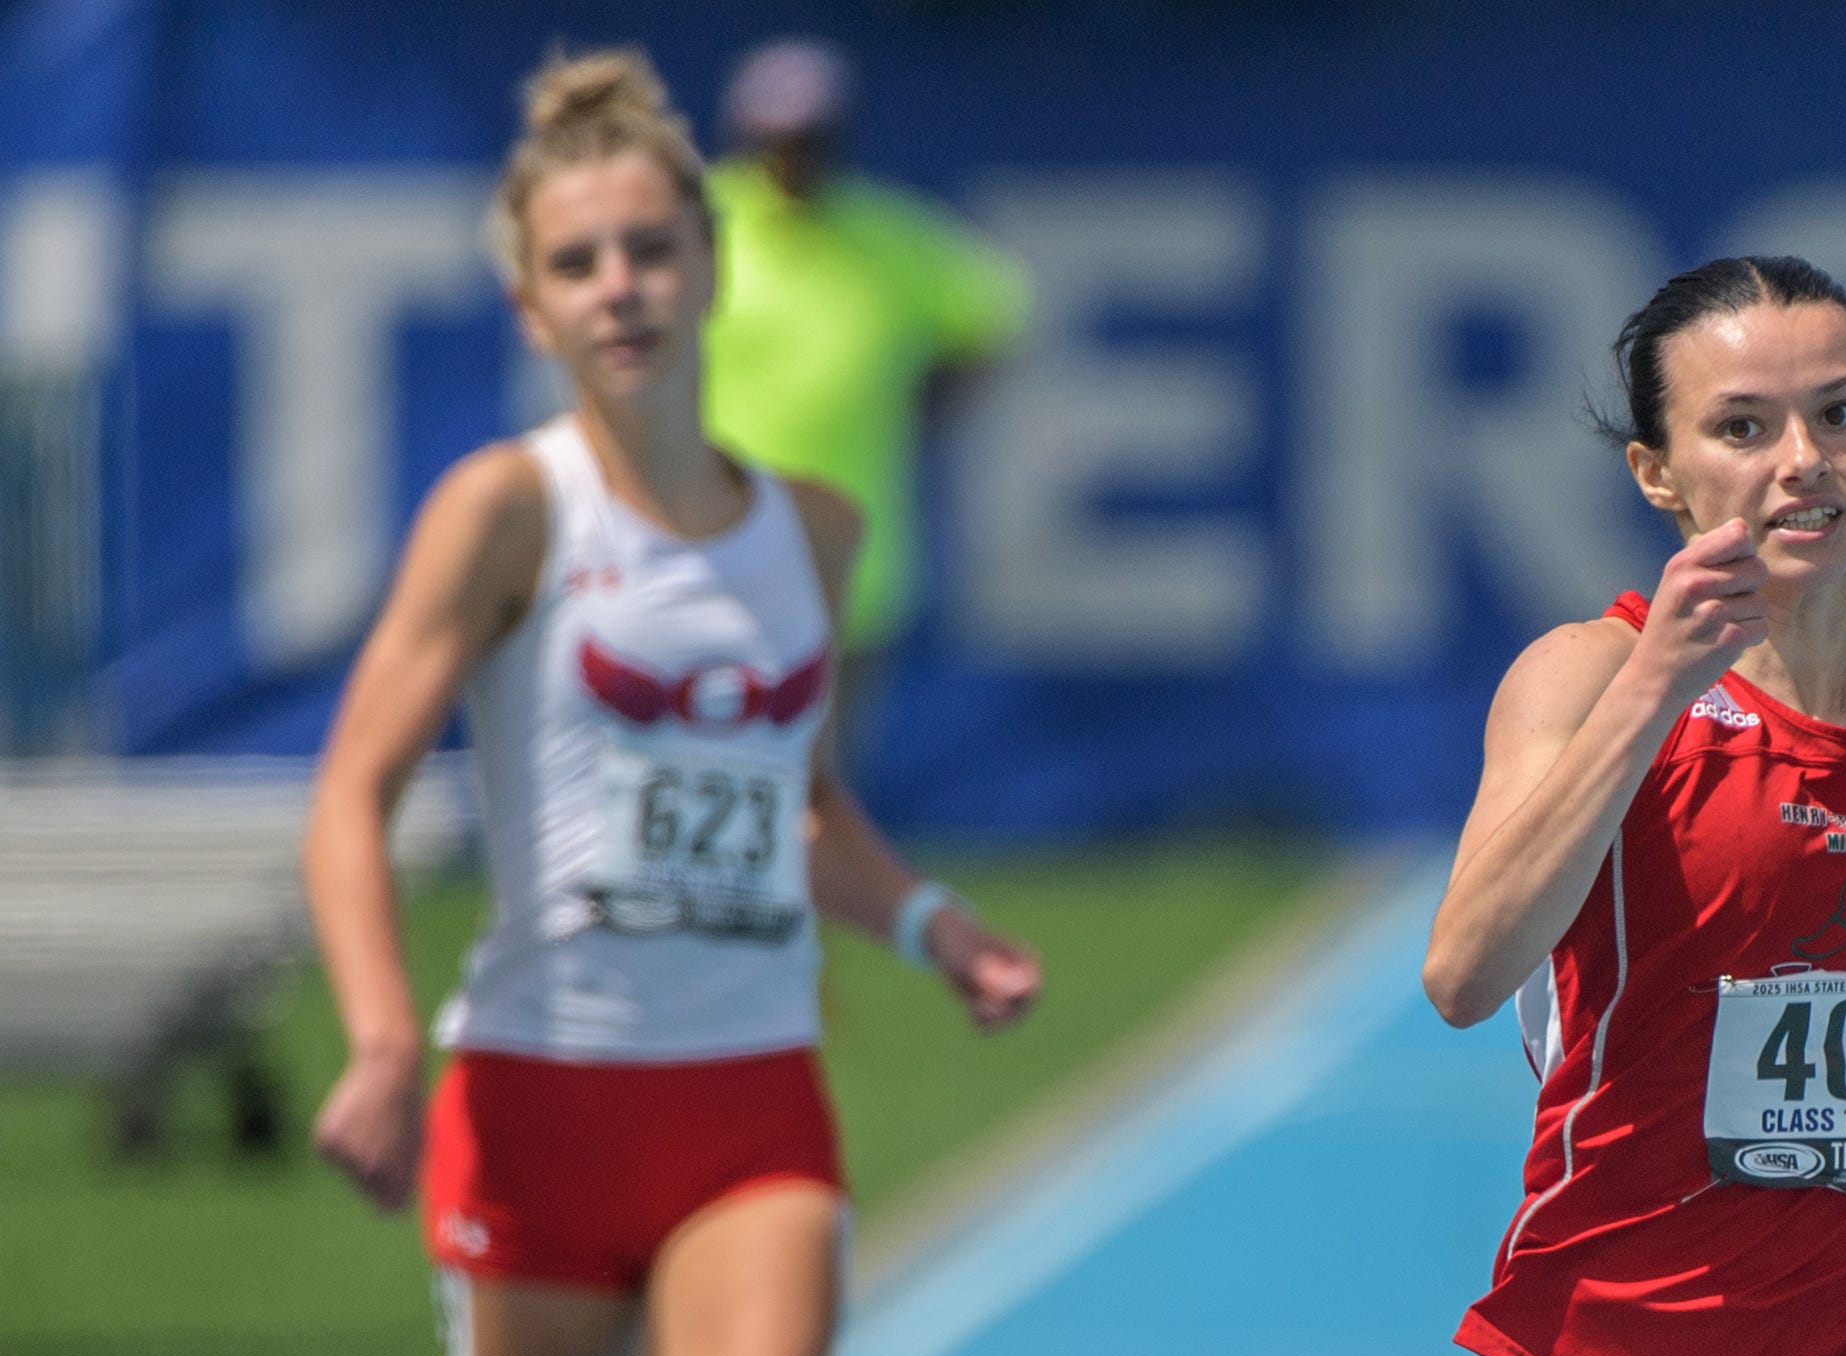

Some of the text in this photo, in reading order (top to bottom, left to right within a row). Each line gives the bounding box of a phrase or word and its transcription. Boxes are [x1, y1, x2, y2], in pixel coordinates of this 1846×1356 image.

[1691, 701, 1761, 727] addas
[640, 765, 778, 868] 623
[1753, 983, 1781, 995] 2025
[1785, 982, 1810, 994] IHSA
[1814, 982, 1845, 993] STATE
[1761, 1108, 1834, 1133] CLASS
